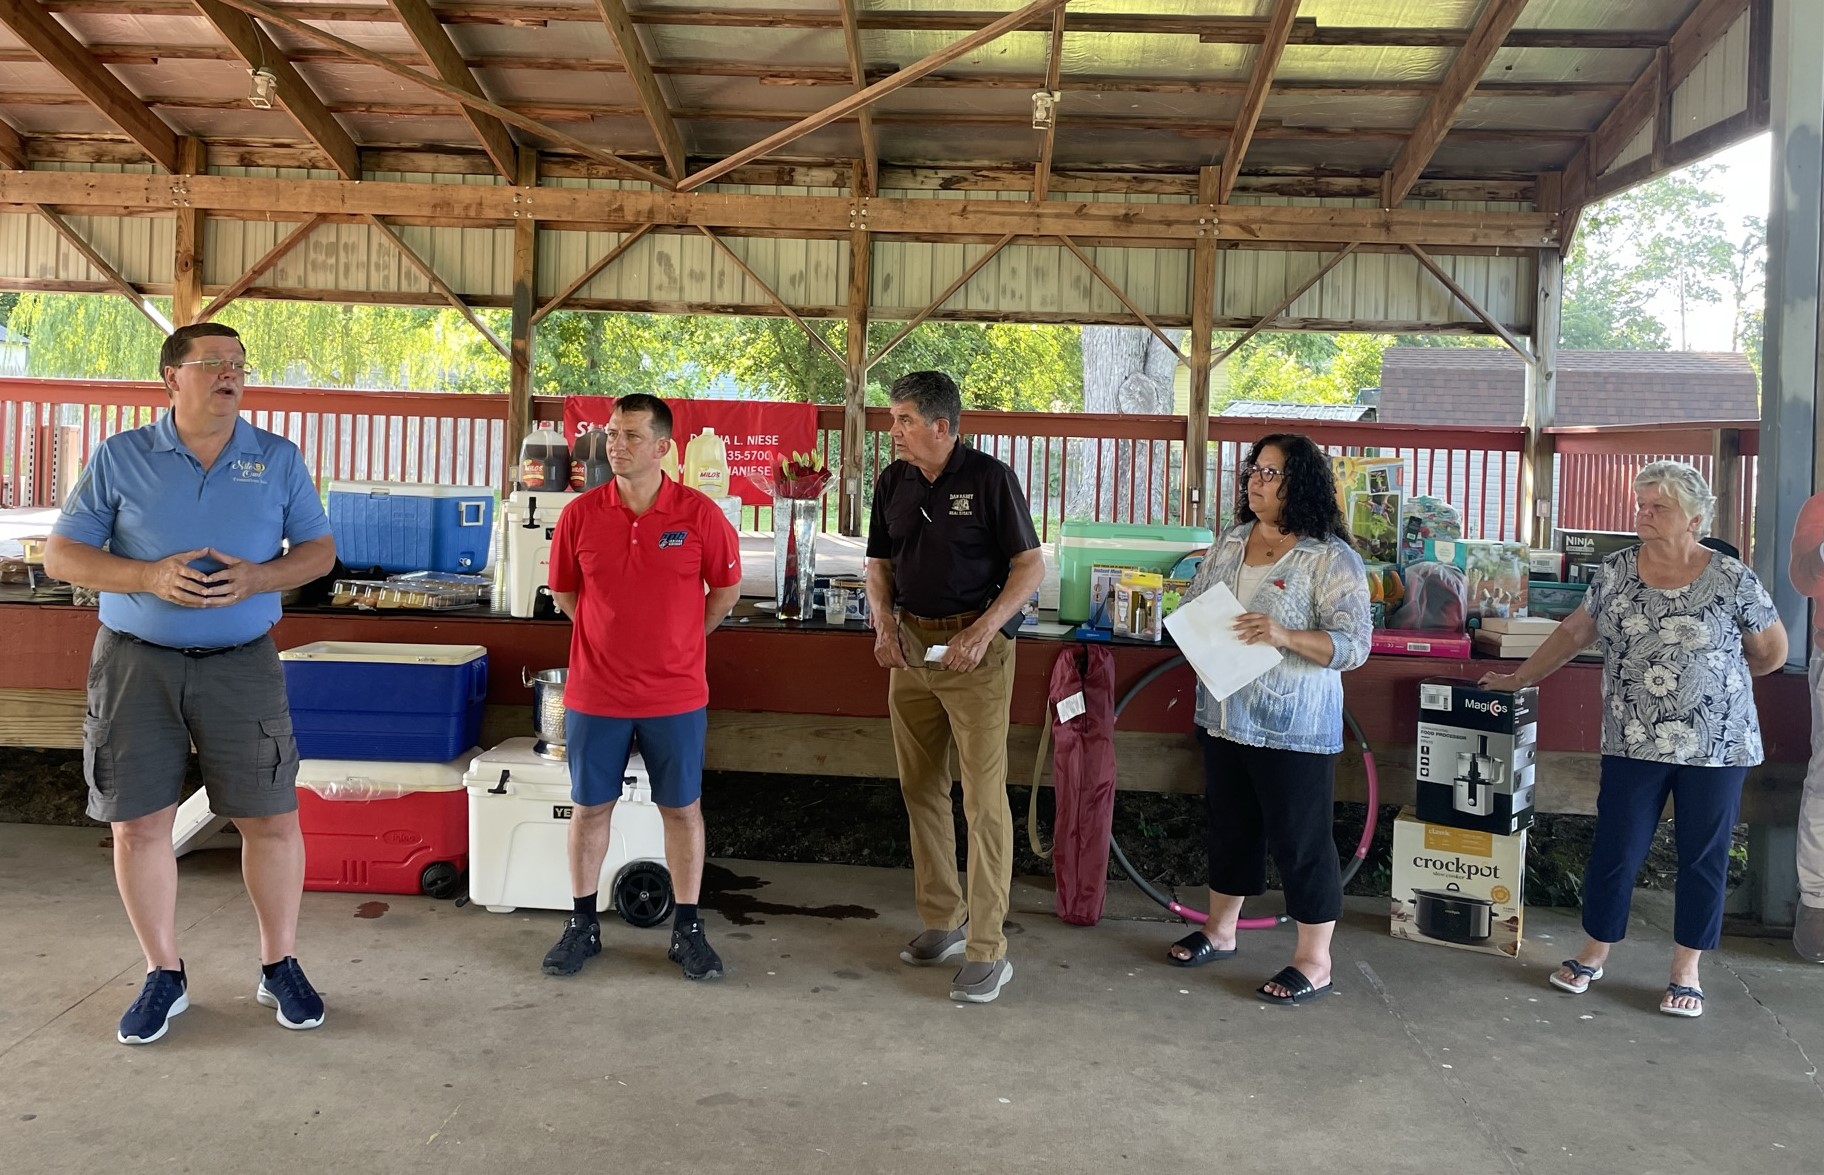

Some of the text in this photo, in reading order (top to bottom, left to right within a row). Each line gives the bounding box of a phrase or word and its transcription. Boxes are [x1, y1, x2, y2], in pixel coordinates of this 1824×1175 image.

[734, 435, 743, 446] L.
[747, 435, 779, 446] NIESE
[727, 450, 771, 461] 35-5700
[1565, 535, 1595, 548] NINJA
[1435, 731, 1467, 741] PROCESSOR
[555, 807, 571, 817] YE
[1428, 828, 1451, 836] classic
[1413, 856, 1501, 880] crockpot
